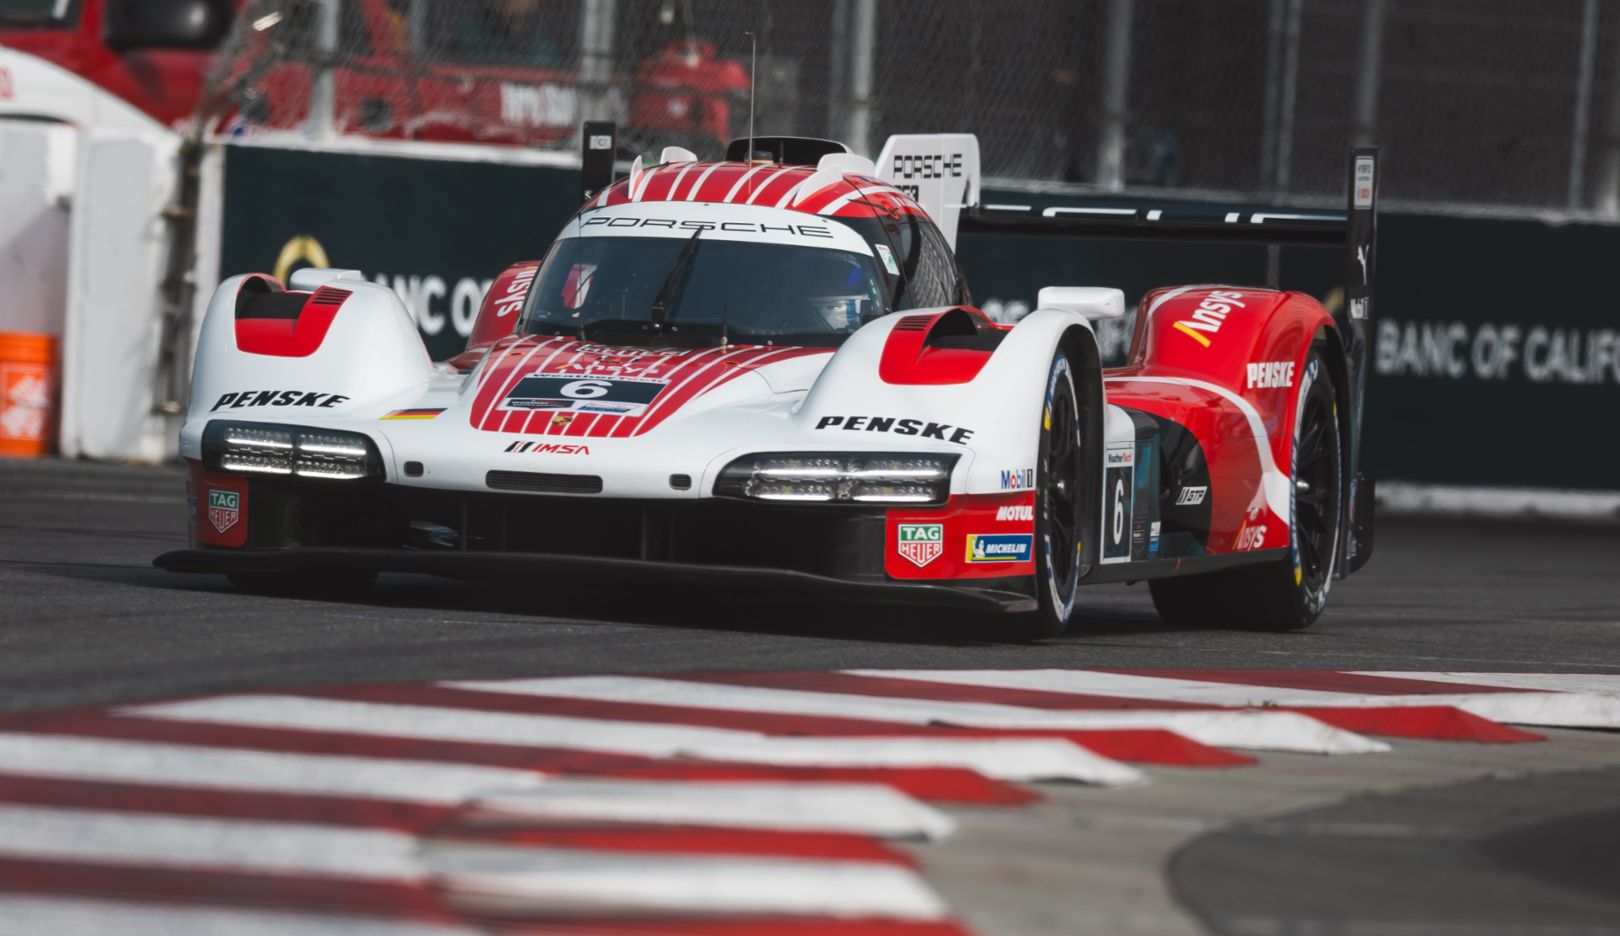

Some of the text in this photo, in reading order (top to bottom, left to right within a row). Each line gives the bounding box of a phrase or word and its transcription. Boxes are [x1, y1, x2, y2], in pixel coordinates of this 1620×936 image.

[893, 153, 962, 179] PORSCHE
[580, 216, 834, 239] PORSCHE
[1172, 290, 1246, 348] Ansys
[1377, 318, 1467, 380] BANC
[1471, 322, 1522, 380] OF
[1246, 361, 1296, 389] PENSKE
[560, 380, 613, 399] 6
[209, 391, 351, 412] PENSKE
[814, 416, 975, 445] PENSKE
[532, 443, 590, 455] IMSA
[1001, 470, 1025, 489] Mobil
[211, 493, 236, 508] TAG
[209, 508, 236, 529] HEUER
[995, 505, 1034, 521] MOTUL
[1113, 479, 1124, 545] 6
[902, 527, 939, 540] TAG
[901, 543, 940, 564] HEUER
[985, 544, 1027, 554] MICHELIN
